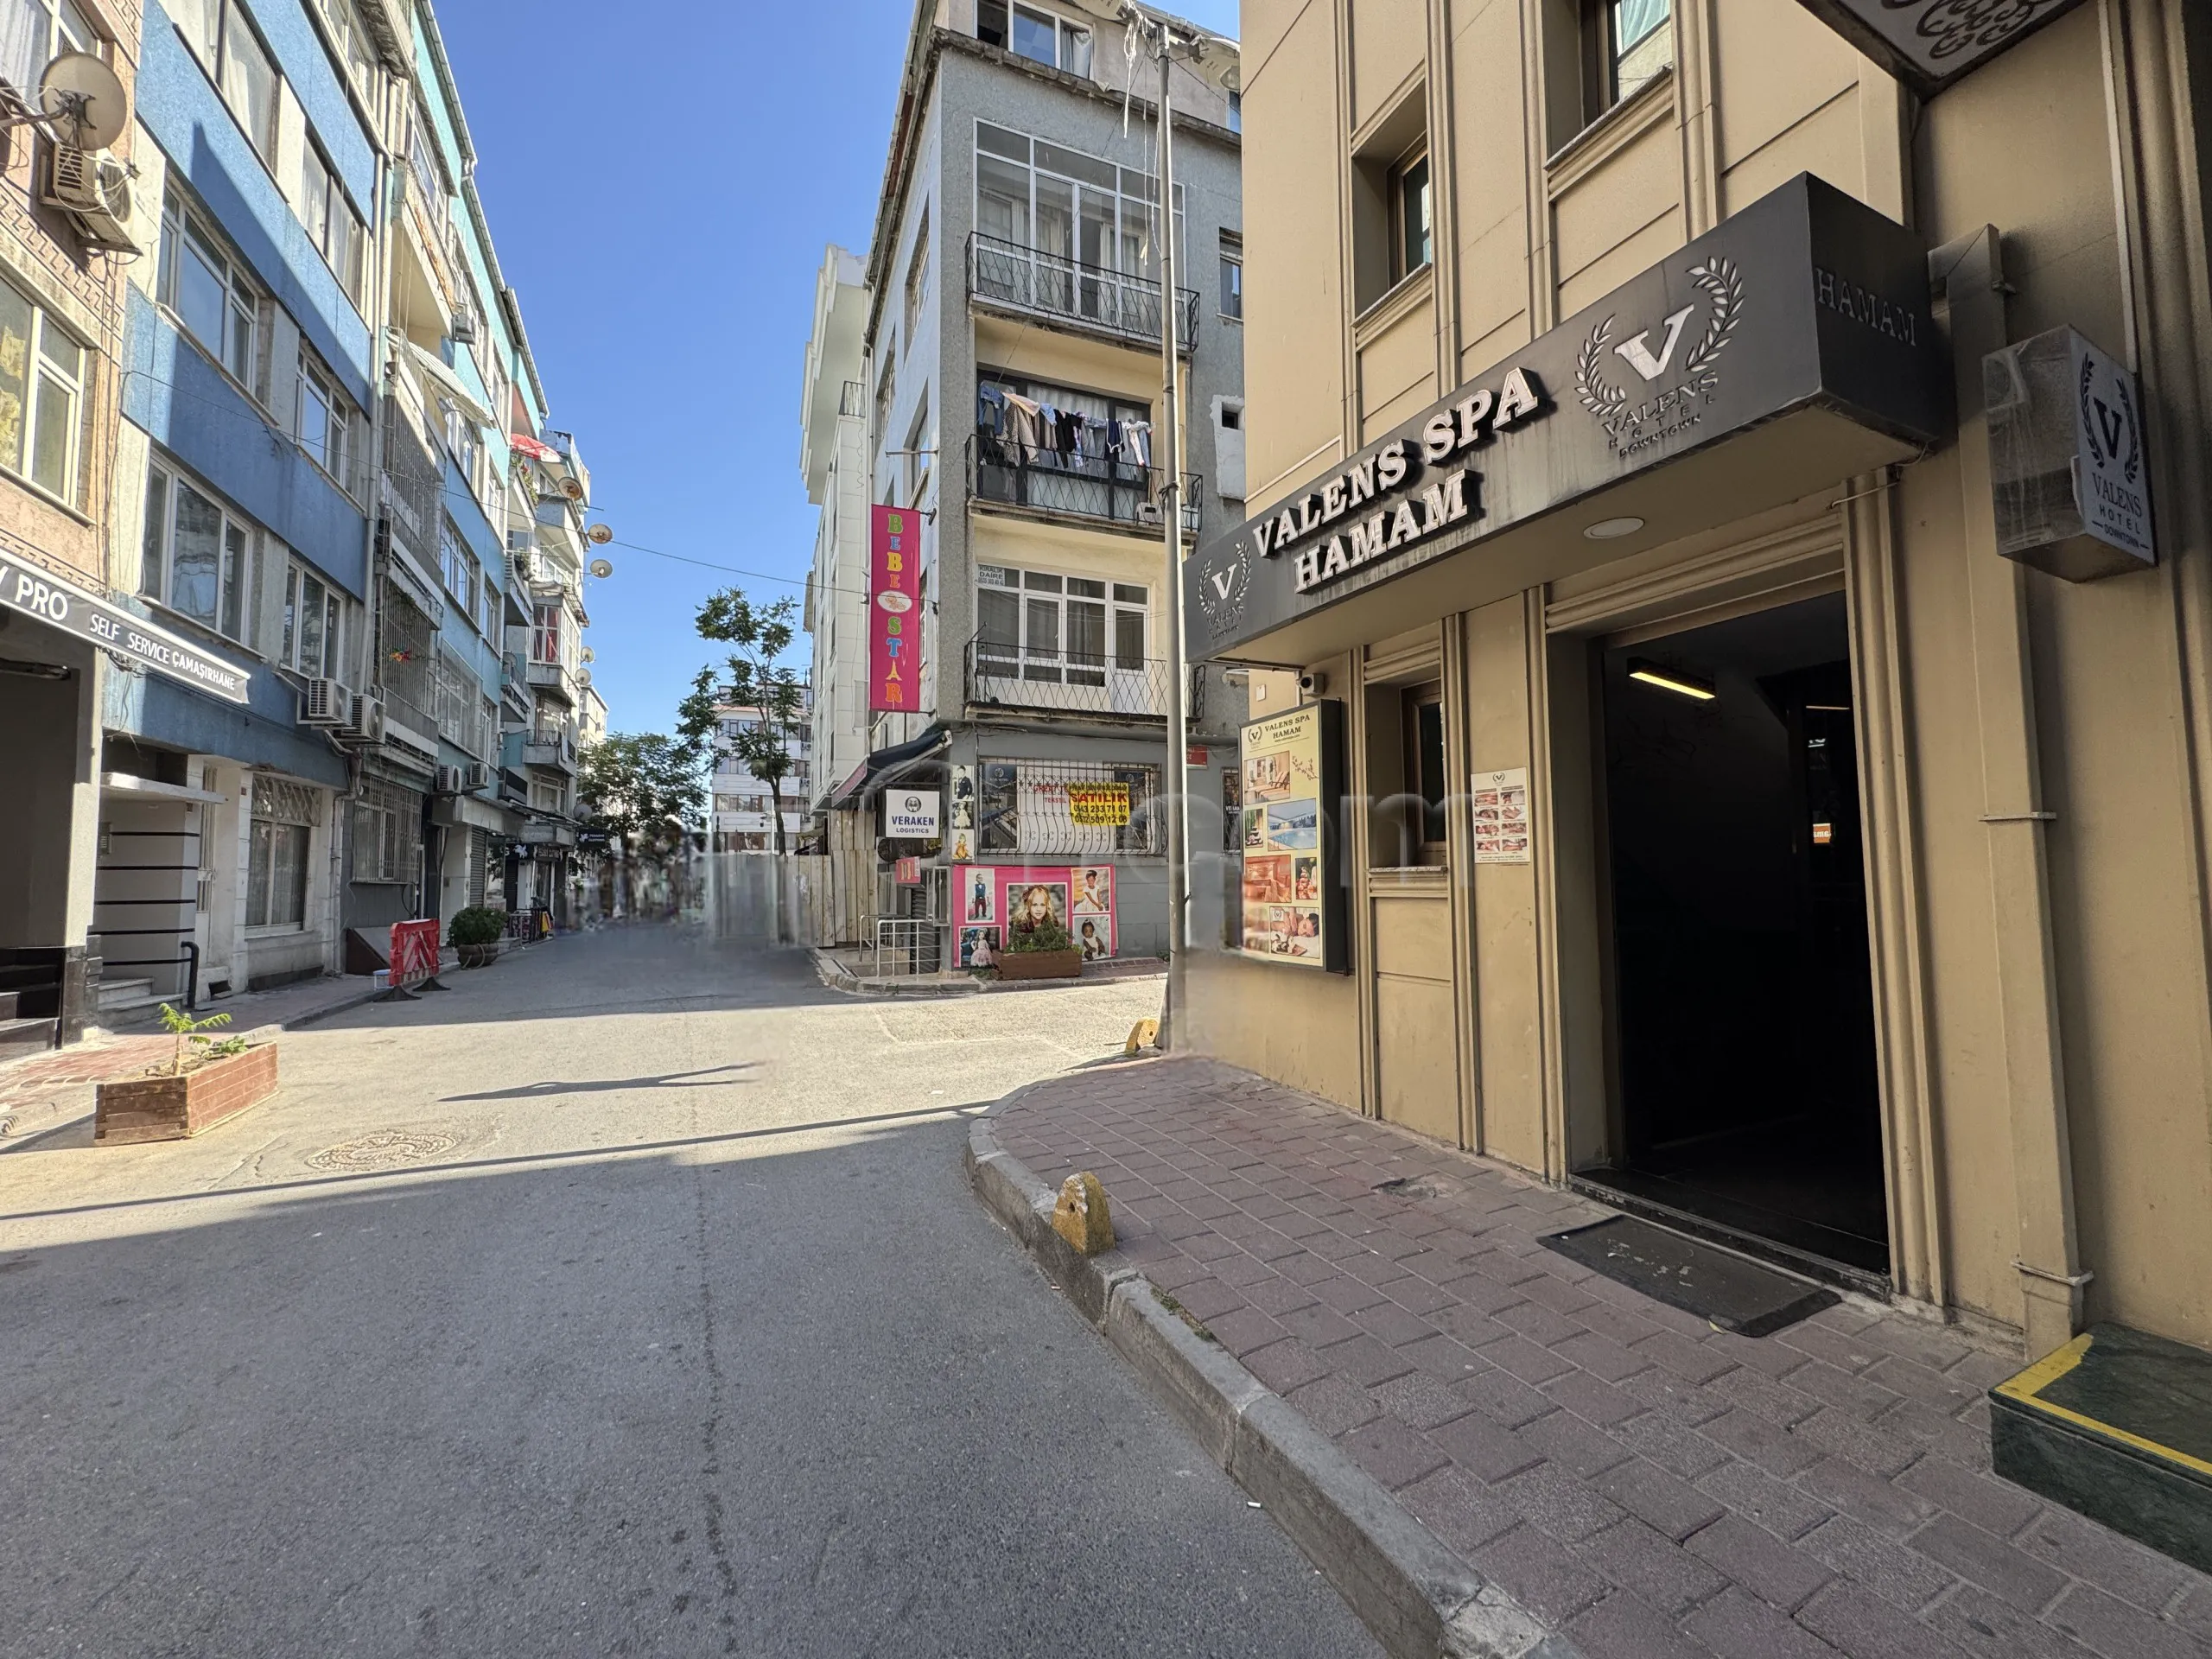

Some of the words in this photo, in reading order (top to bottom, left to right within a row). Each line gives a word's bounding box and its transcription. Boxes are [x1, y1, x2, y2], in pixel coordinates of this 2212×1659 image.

[1815, 267, 1916, 346] HAMAM
[1612, 302, 1694, 381] V
[1602, 371, 1719, 435] VALENS
[1609, 394, 1716, 450] HOTEL
[2093, 397, 2123, 460] V
[1619, 413, 1701, 459] DOWNTOWN
[1253, 439, 1407, 559] VALENS
[1423, 366, 1538, 465] SPA
[2092, 472, 2142, 518] VALENS
[2100, 504, 2141, 535] HOTEL
[887, 513, 904, 589] BEBE
[1294, 469, 1468, 594] HAMAM
[2104, 523, 2139, 550] DOWNTOWN
[1211, 563, 1237, 601] V
[15, 574, 68, 621] PRO
[90, 613, 121, 641] SELF
[127, 632, 170, 664] SERVICE
[885, 616, 903, 703] STAR
[1264, 719, 1294, 733] VALENS
[1294, 714, 1311, 724] SPA
[1273, 726, 1301, 739] HAMAM
[891, 815, 935, 826] VERAKEN
[1071, 792, 1128, 803] SATILIK
[1118, 804, 1127, 813] 07
